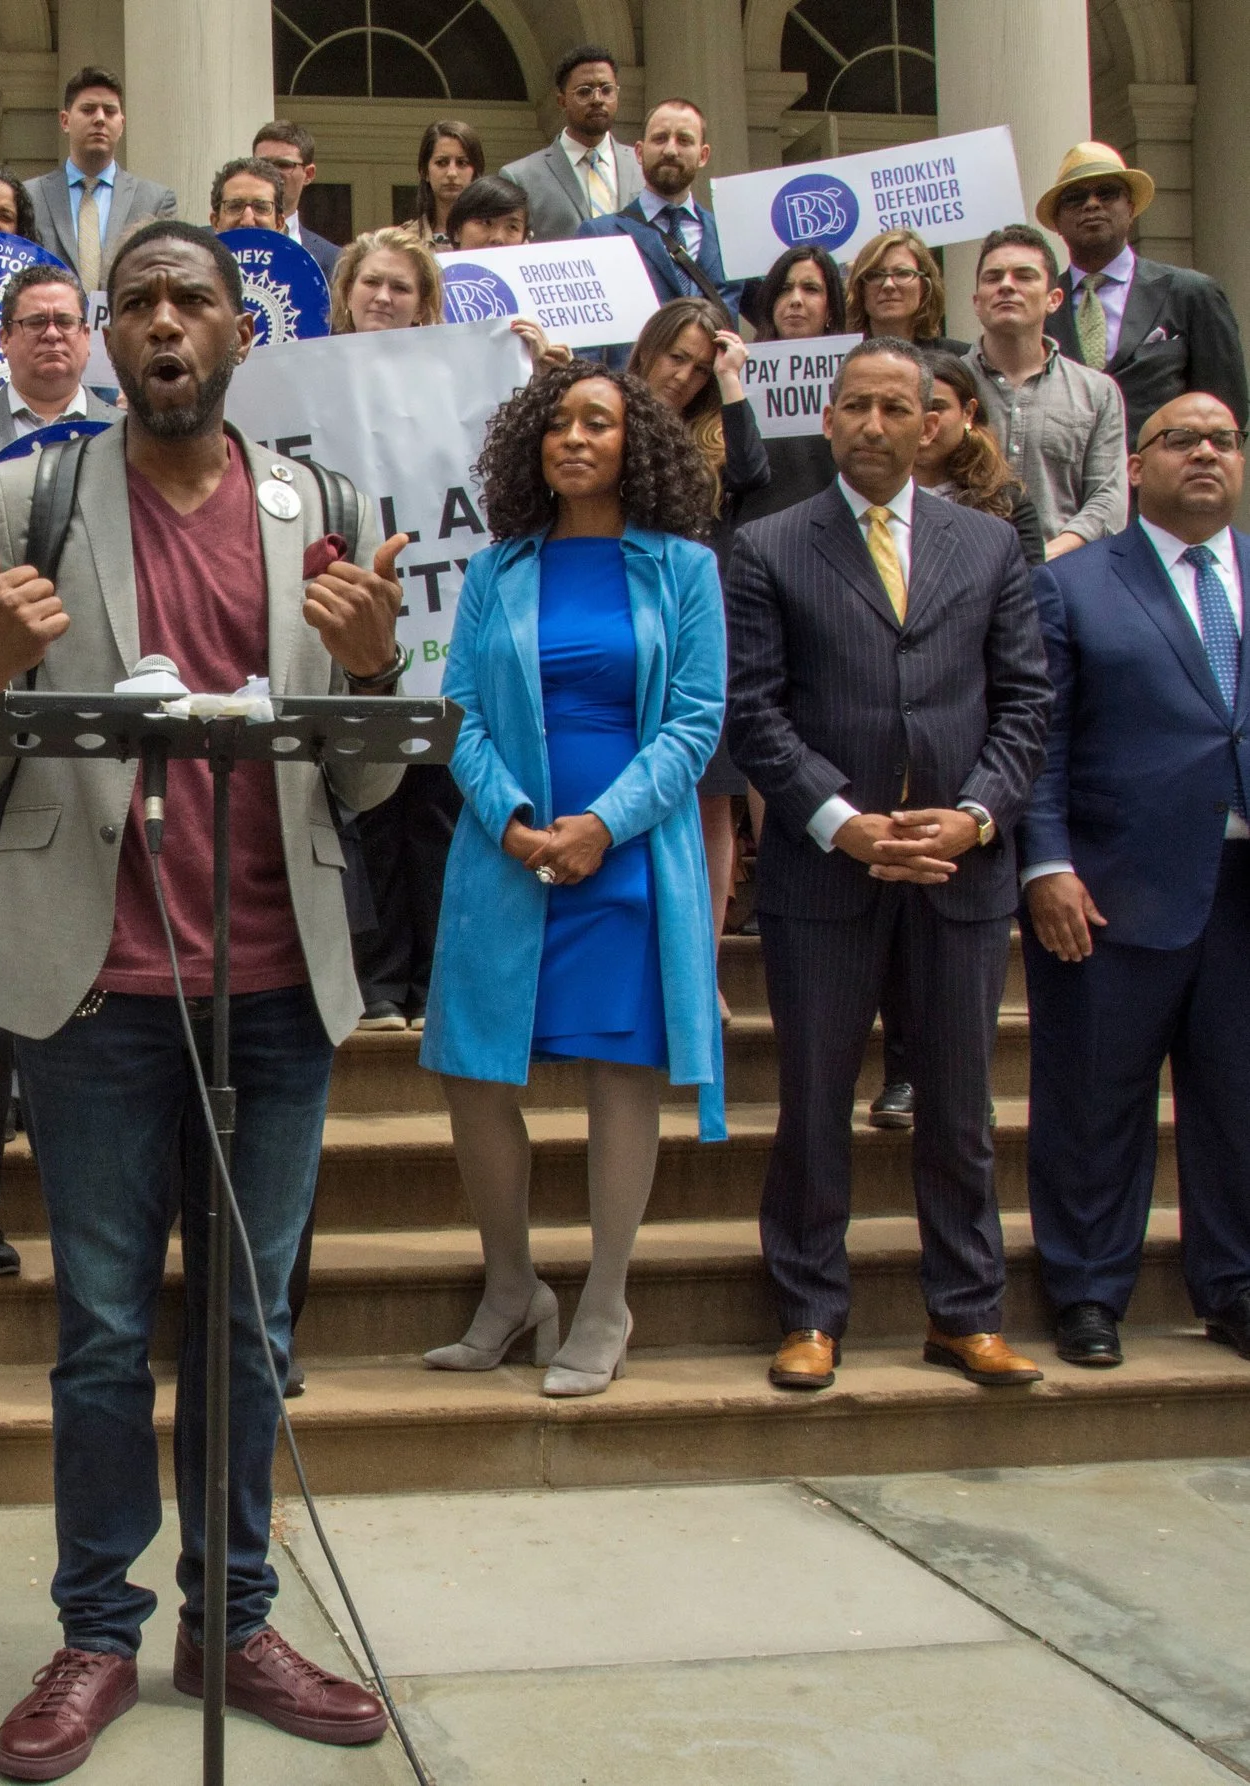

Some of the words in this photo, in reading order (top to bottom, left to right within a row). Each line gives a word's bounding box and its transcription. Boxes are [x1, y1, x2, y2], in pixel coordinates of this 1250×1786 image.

[870, 157, 956, 190] BROOKLYN
[874, 179, 961, 212] DEFENDER
[878, 201, 964, 234] SERVICES
[19, 251, 35, 263] OF
[519, 258, 596, 284] BROOKLYN
[528, 280, 606, 306] DEFENDER
[537, 302, 614, 329] SERVICES
[745, 359, 780, 385] PAY
[790, 354, 845, 381] PARIT
